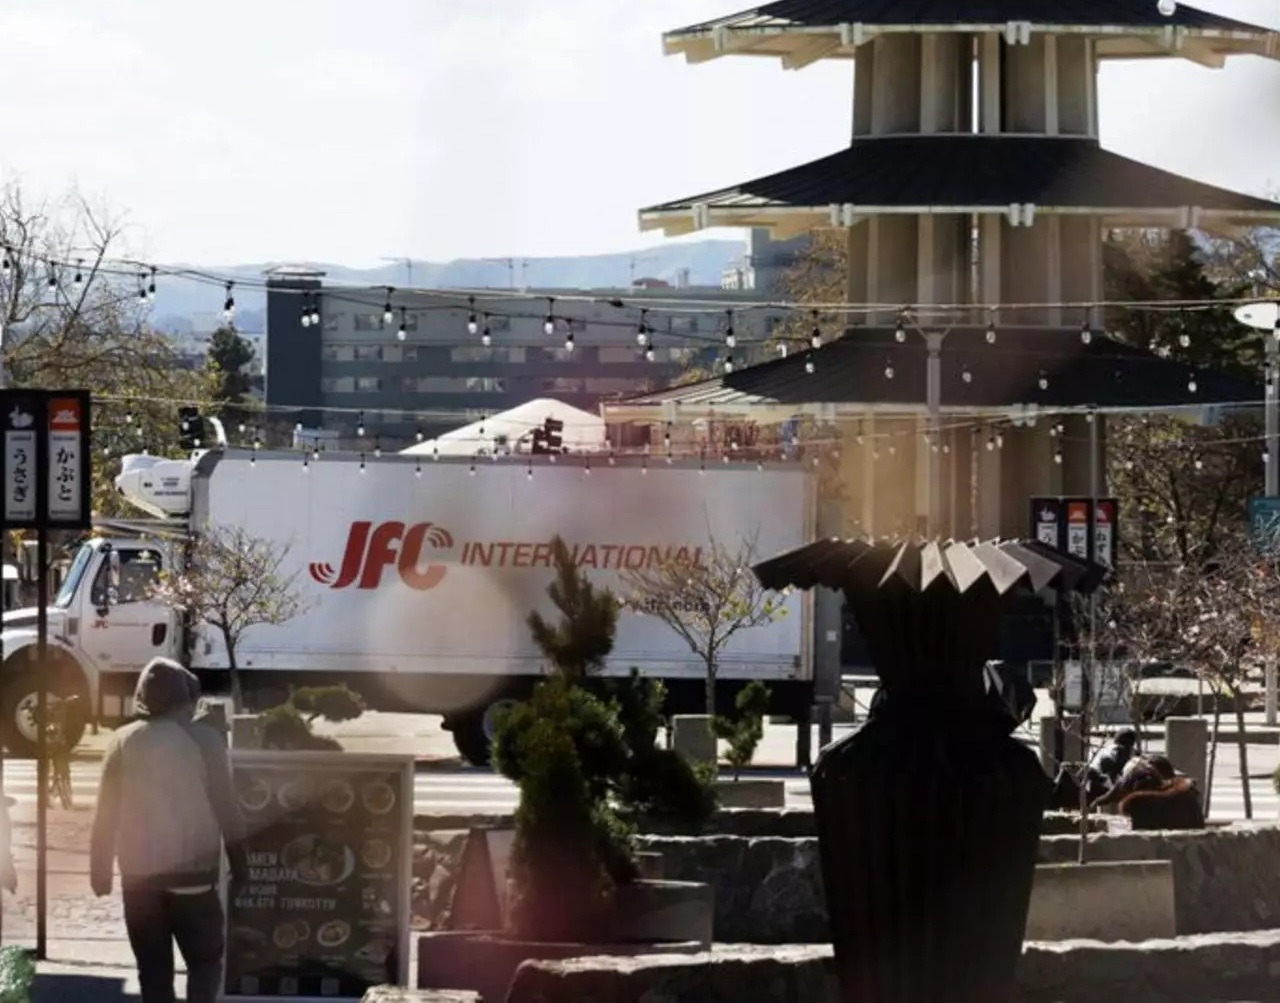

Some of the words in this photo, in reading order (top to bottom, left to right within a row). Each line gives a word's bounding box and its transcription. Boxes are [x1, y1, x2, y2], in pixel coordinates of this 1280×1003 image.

[13, 447, 28, 503] うさぎ
[56, 446, 75, 502] かぶと
[309, 520, 454, 591] JFC
[460, 542, 706, 570] INTERATIONAL
